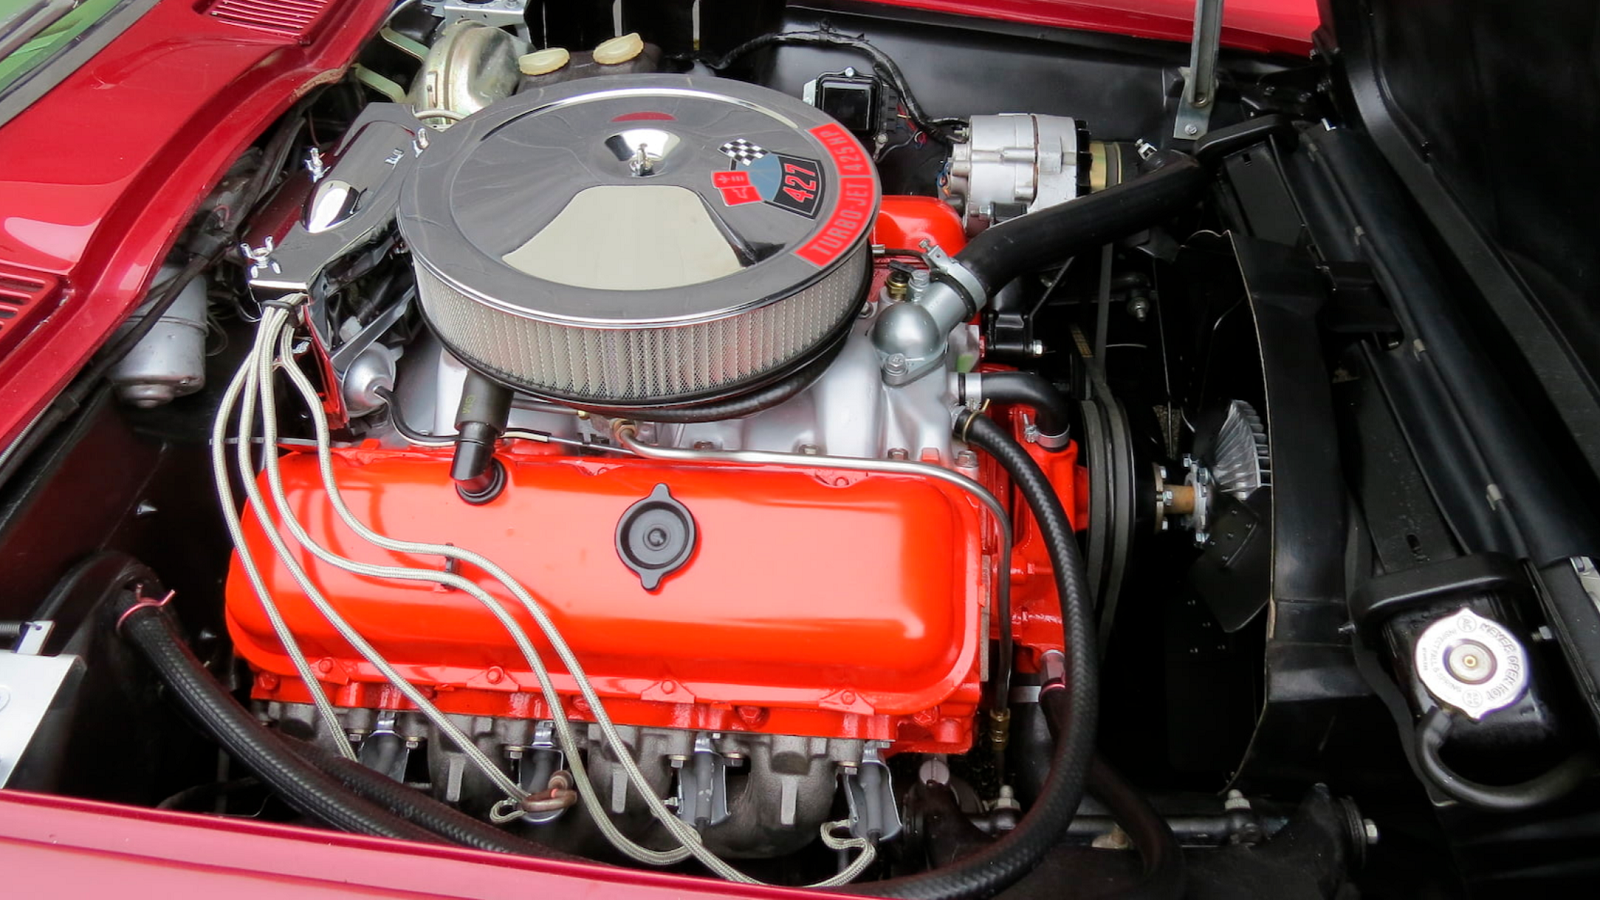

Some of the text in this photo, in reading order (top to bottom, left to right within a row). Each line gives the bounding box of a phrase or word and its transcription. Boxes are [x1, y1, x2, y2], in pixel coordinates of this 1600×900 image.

[819, 130, 847, 146] HP
[835, 144, 864, 172] 425
[783, 163, 816, 203] 427
